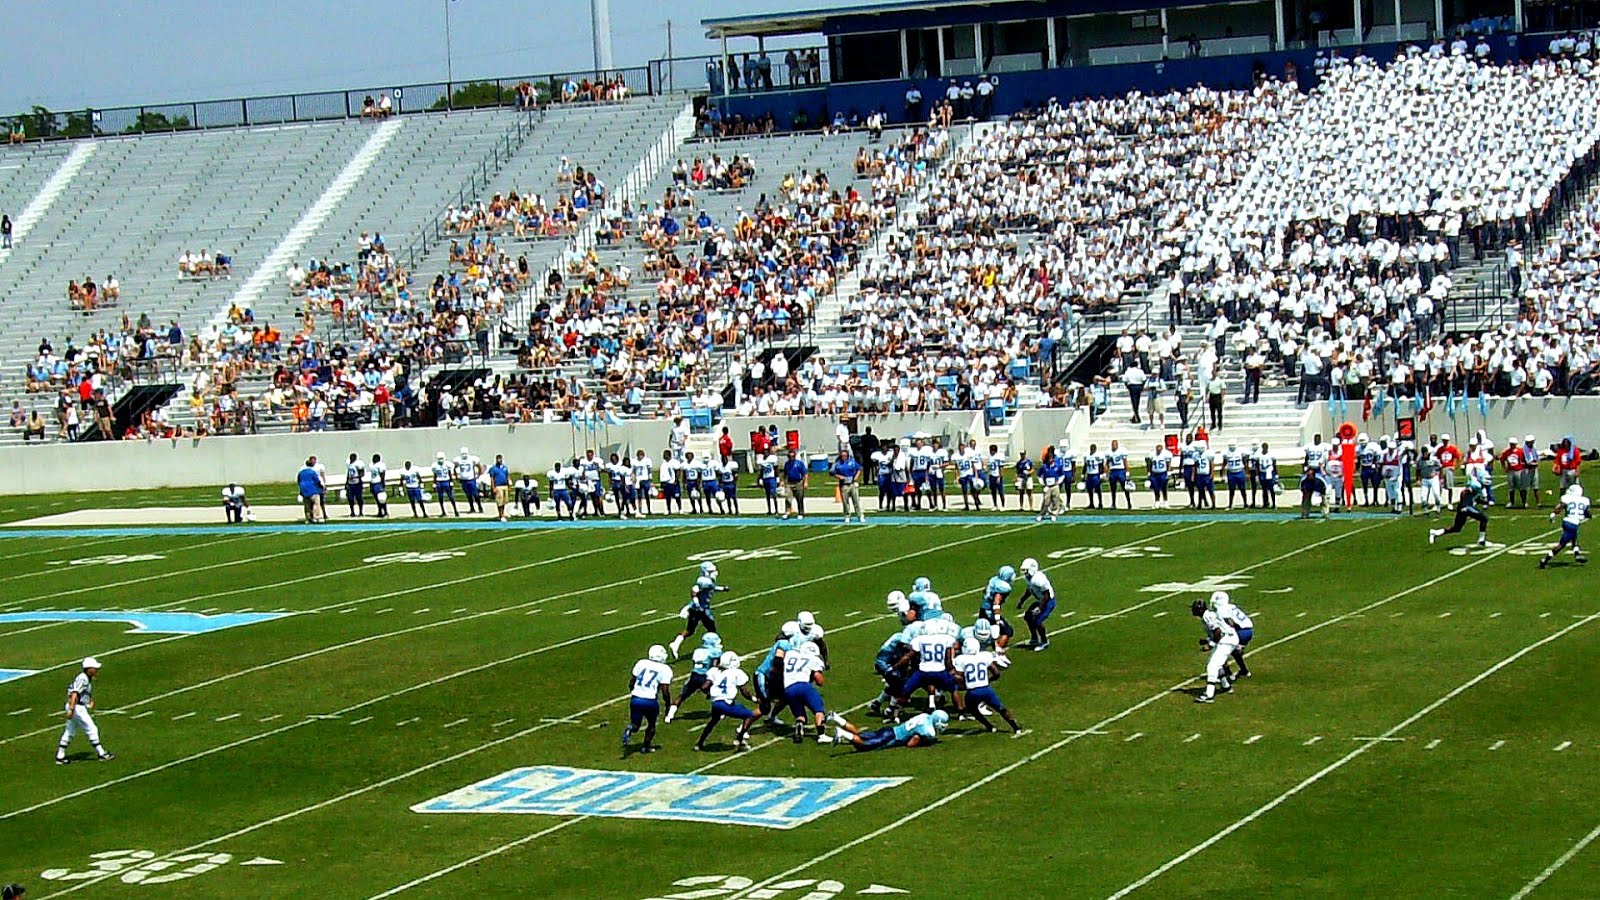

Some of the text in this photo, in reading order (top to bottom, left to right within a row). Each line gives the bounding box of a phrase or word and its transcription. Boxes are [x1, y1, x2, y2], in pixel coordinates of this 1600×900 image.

[1399, 420, 1413, 437] 2
[1566, 501, 1587, 517] 29
[920, 643, 945, 663] 58
[785, 656, 810, 673] 97
[964, 662, 987, 683] 26
[636, 668, 659, 688] 47
[717, 676, 728, 695] 4
